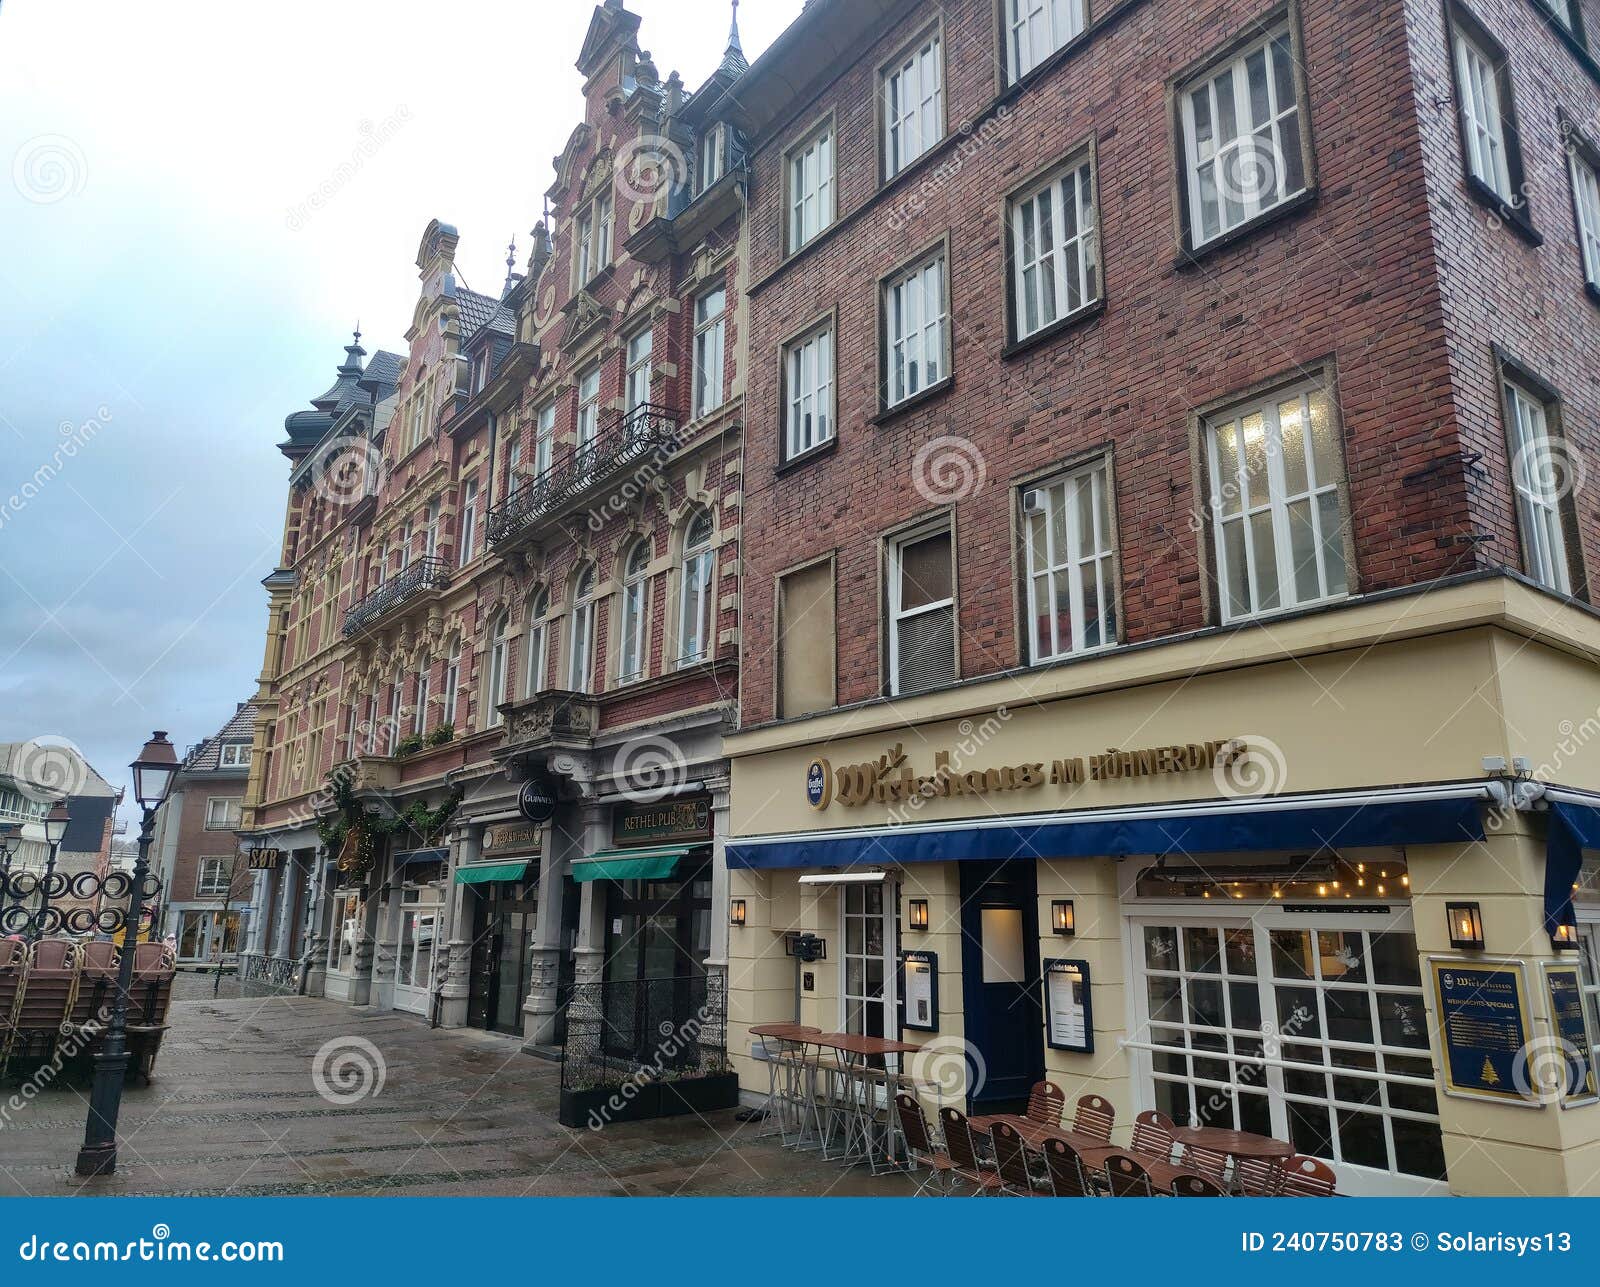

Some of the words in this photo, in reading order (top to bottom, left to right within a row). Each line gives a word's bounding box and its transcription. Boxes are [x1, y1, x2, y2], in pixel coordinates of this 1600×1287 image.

[1050, 757, 1084, 784] AM
[1089, 738, 1249, 781] HÜHNERDIEB
[658, 811, 677, 827] PUB
[249, 849, 278, 868] SØR
